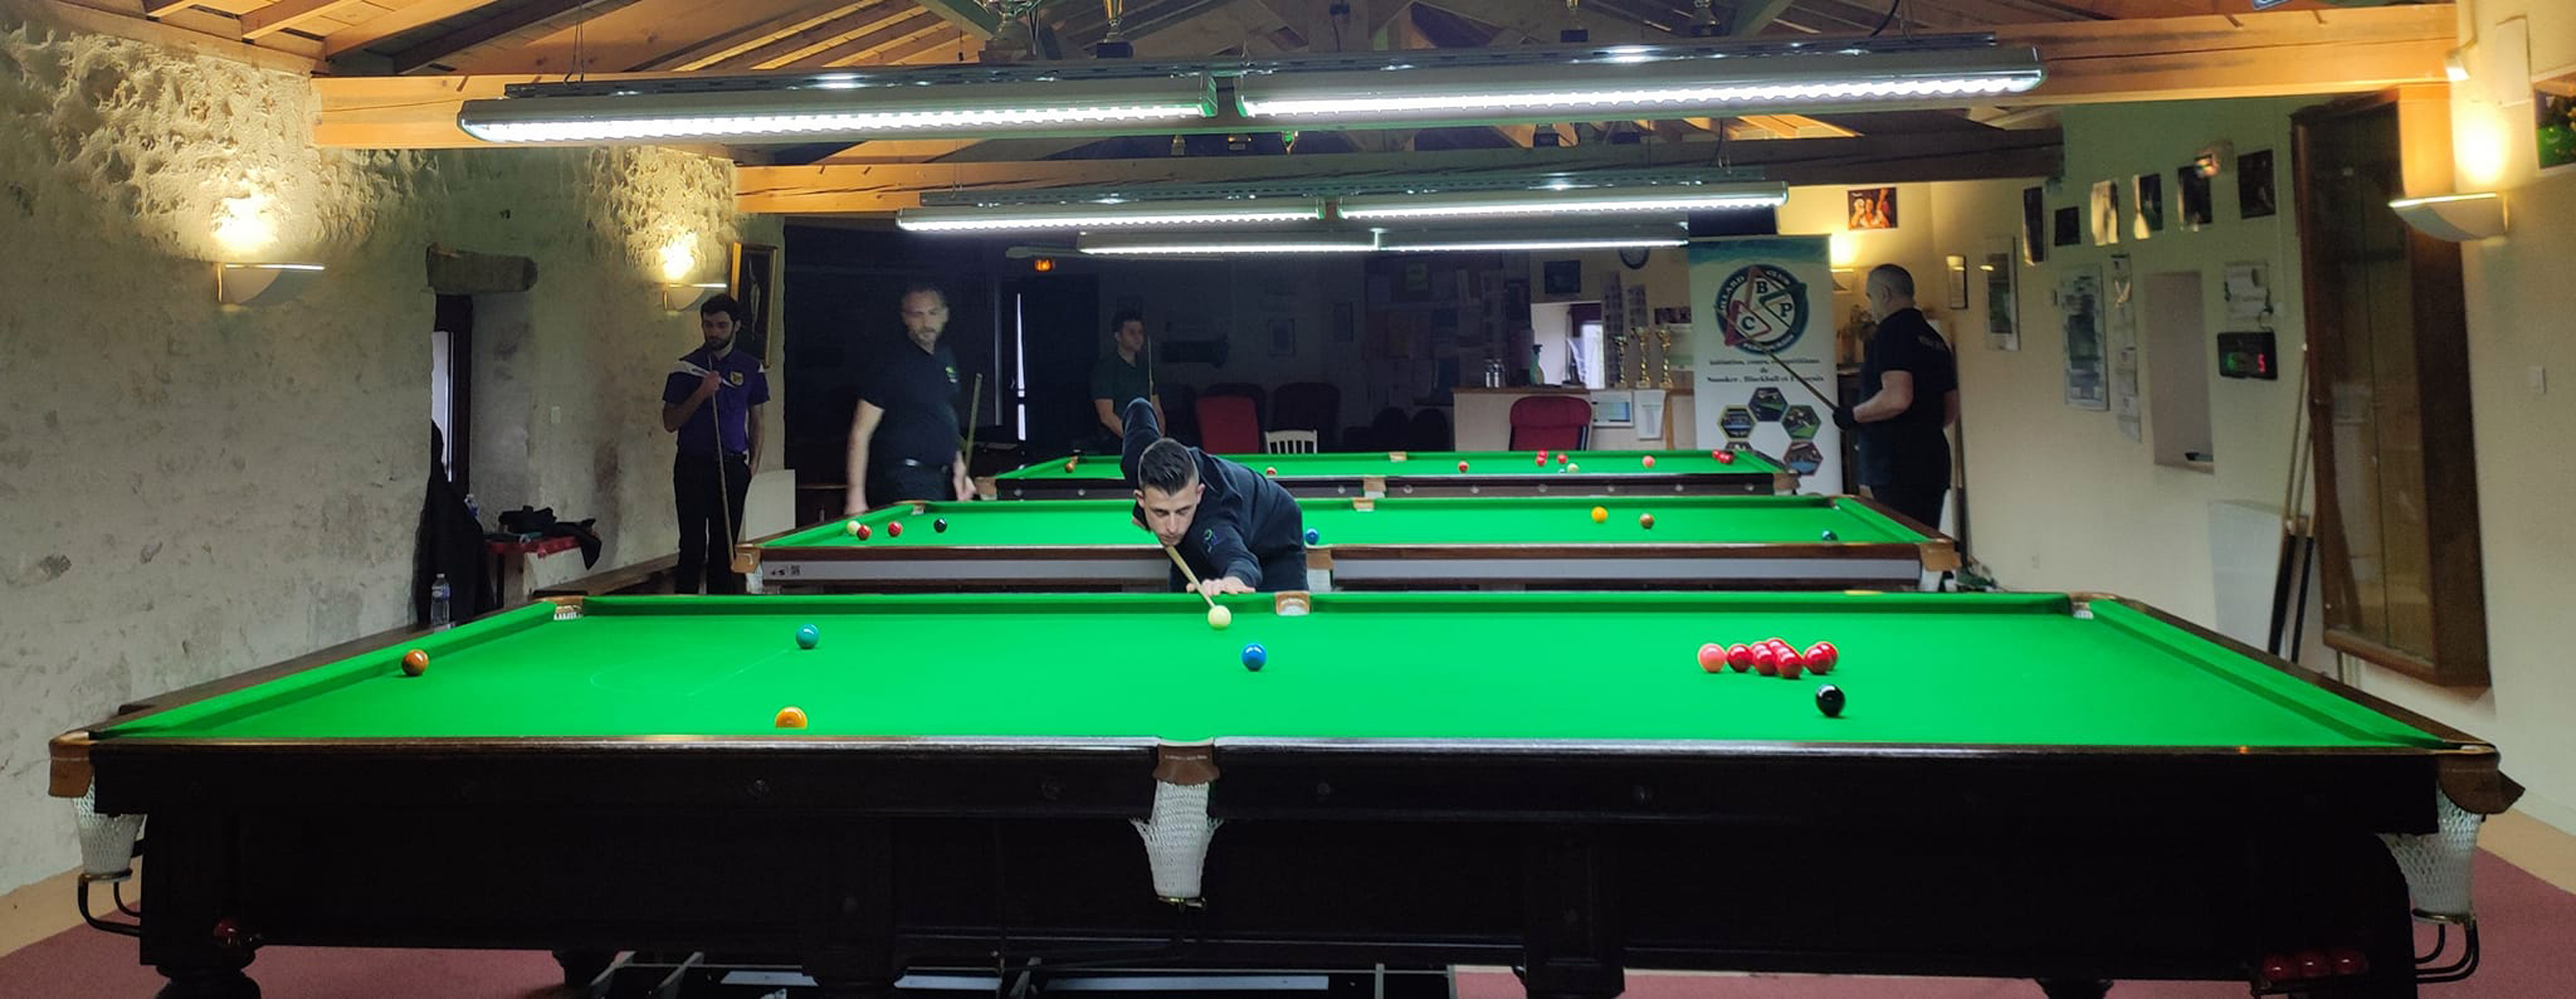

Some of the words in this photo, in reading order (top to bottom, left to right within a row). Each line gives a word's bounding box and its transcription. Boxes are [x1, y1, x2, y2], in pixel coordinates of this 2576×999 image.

[1756, 281, 1769, 294] B
[1780, 302, 1794, 317] P
[1742, 316, 1757, 331] C
